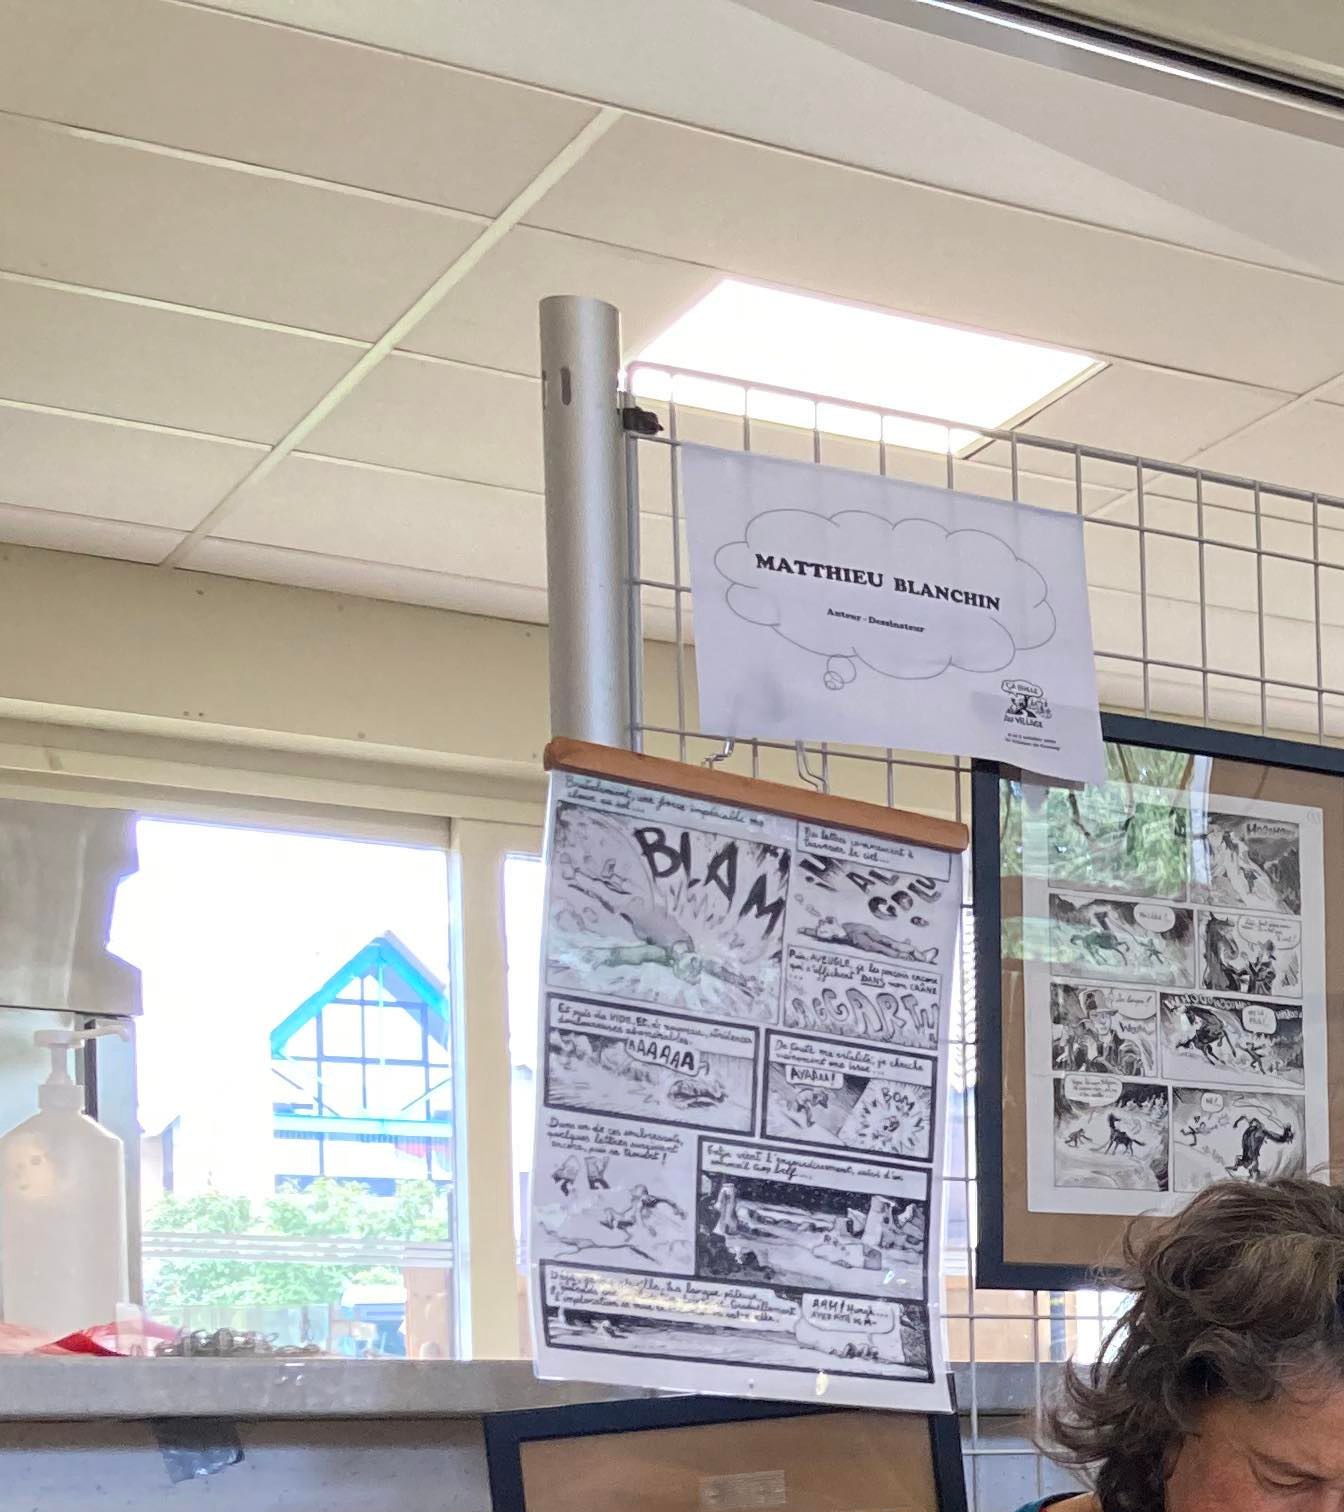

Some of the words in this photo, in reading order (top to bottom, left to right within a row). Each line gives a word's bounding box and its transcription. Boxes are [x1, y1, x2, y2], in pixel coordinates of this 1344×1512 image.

[755, 553, 884, 588] MATTHIEU
[893, 577, 1001, 611] BLANCHIN
[827, 608, 862, 622] Auteur
[868, 615, 926, 633] Dessinateur
